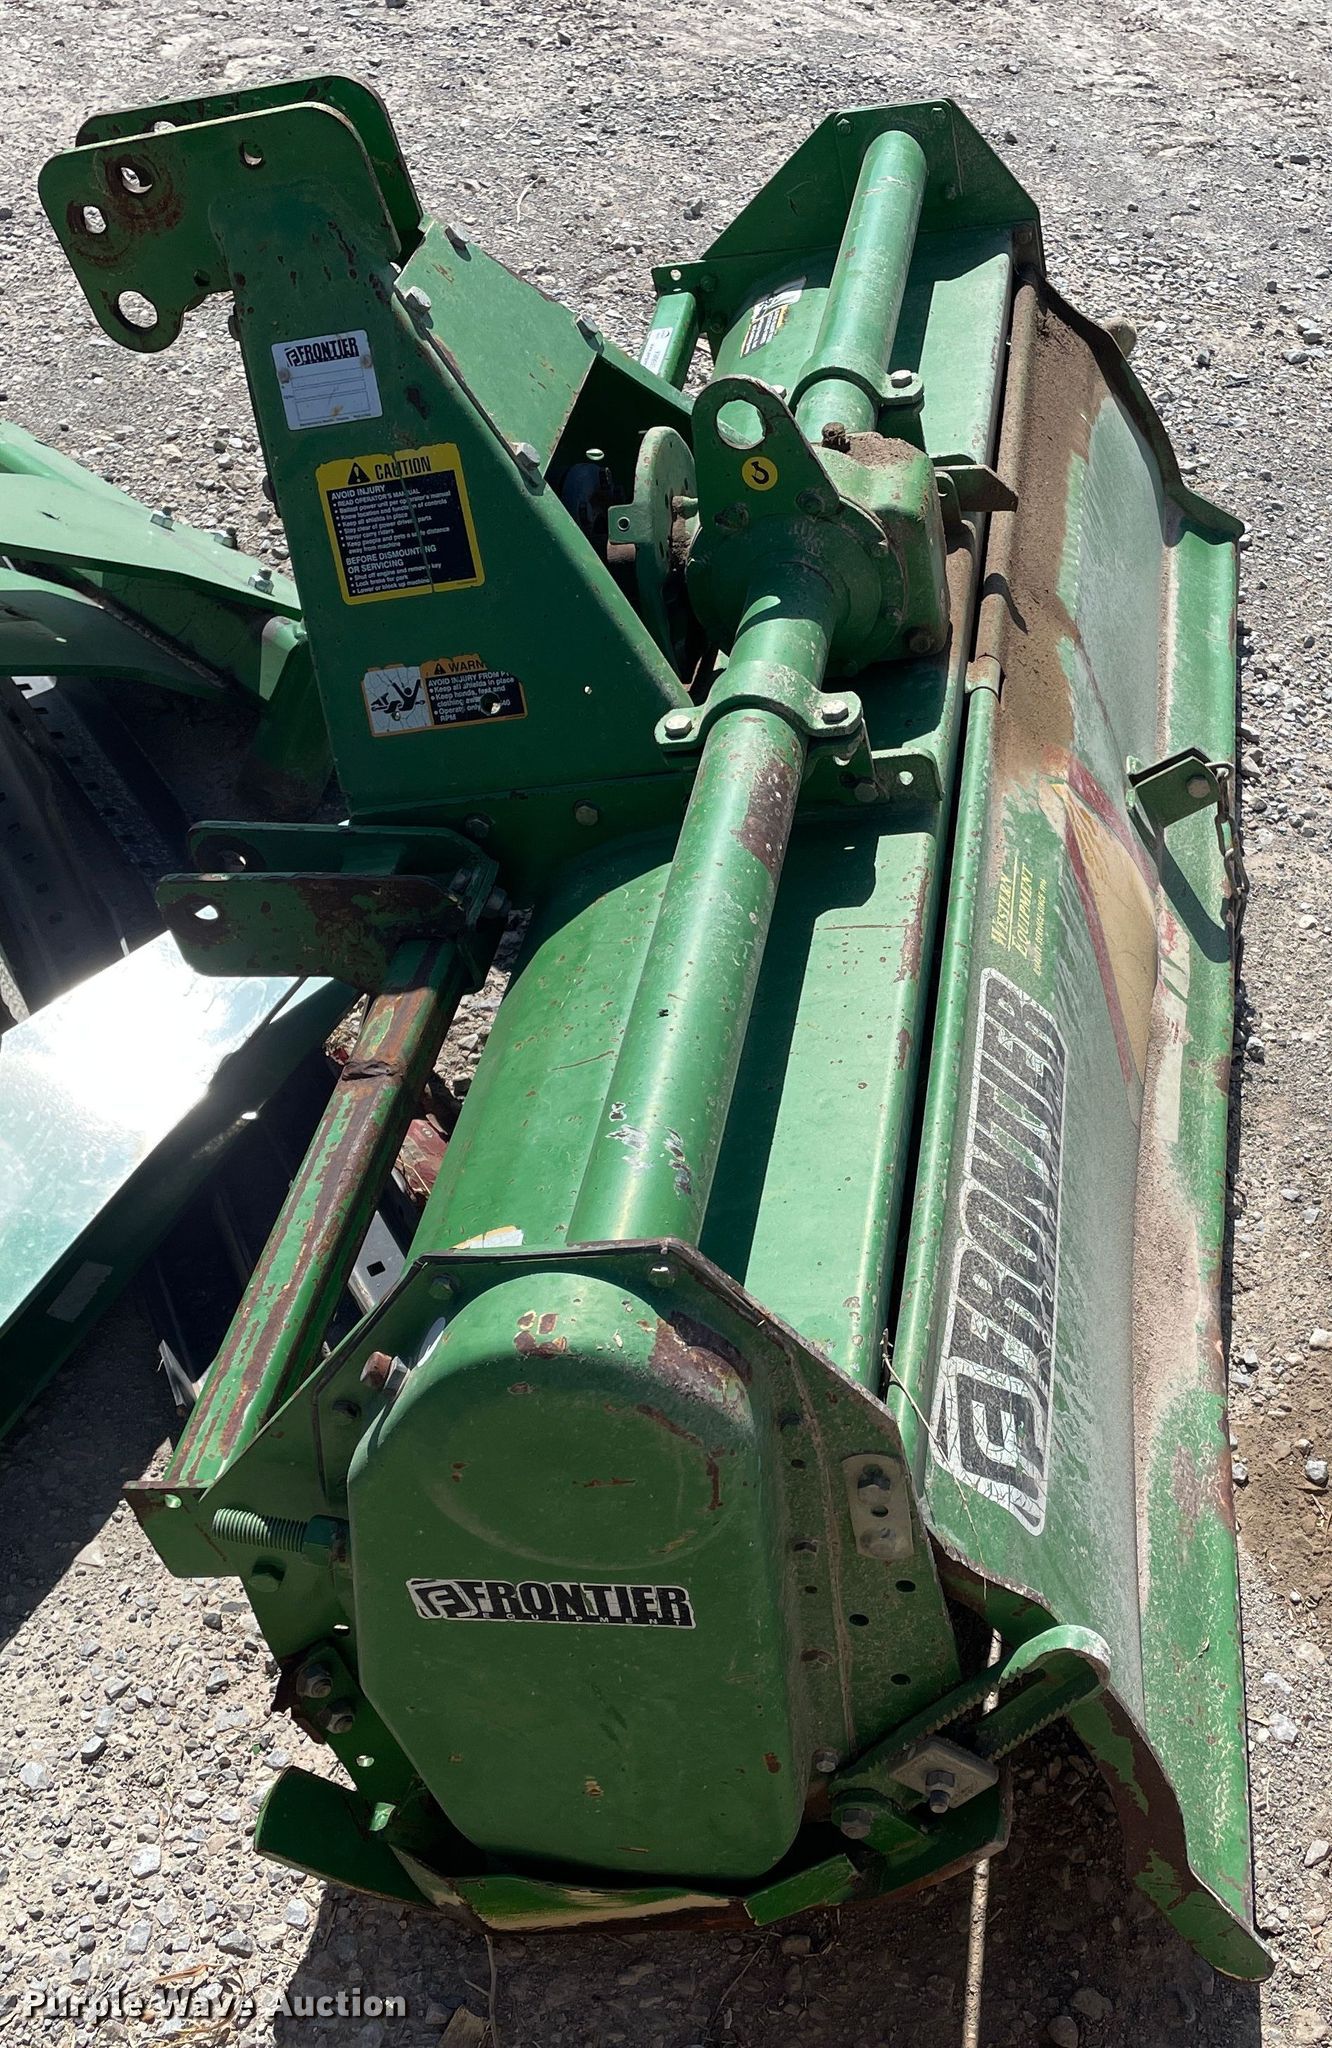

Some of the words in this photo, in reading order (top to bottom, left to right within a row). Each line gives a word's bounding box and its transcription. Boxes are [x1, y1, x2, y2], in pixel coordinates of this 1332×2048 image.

[296, 337, 360, 364] FRONTIER
[374, 456, 432, 480] CAUTION
[331, 489, 355, 500] AVOID
[357, 484, 385, 496] INJURY
[337, 499, 354, 507] READ
[342, 520, 357, 528] Keep
[346, 553, 378, 566] BEFORE
[347, 566, 360, 574] OR
[361, 558, 404, 573] SERVICING
[428, 678, 450, 687] AVOID
[451, 674, 477, 684] INJURY
[478, 671, 499, 680] FROM
[434, 685, 452, 694] Keep
[462, 681, 486, 689] shields
[496, 677, 514, 685] place
[436, 692, 453, 702] Keep
[437, 698, 464, 709] clothing
[465, 696, 481, 704] awa
[1011, 862, 1032, 960] EQUIPMENT
[948, 977, 1066, 1390] FRONTIER
[454, 1580, 693, 1624] FRONTIER
[482, 1612, 682, 1626] EQUIPMENT
